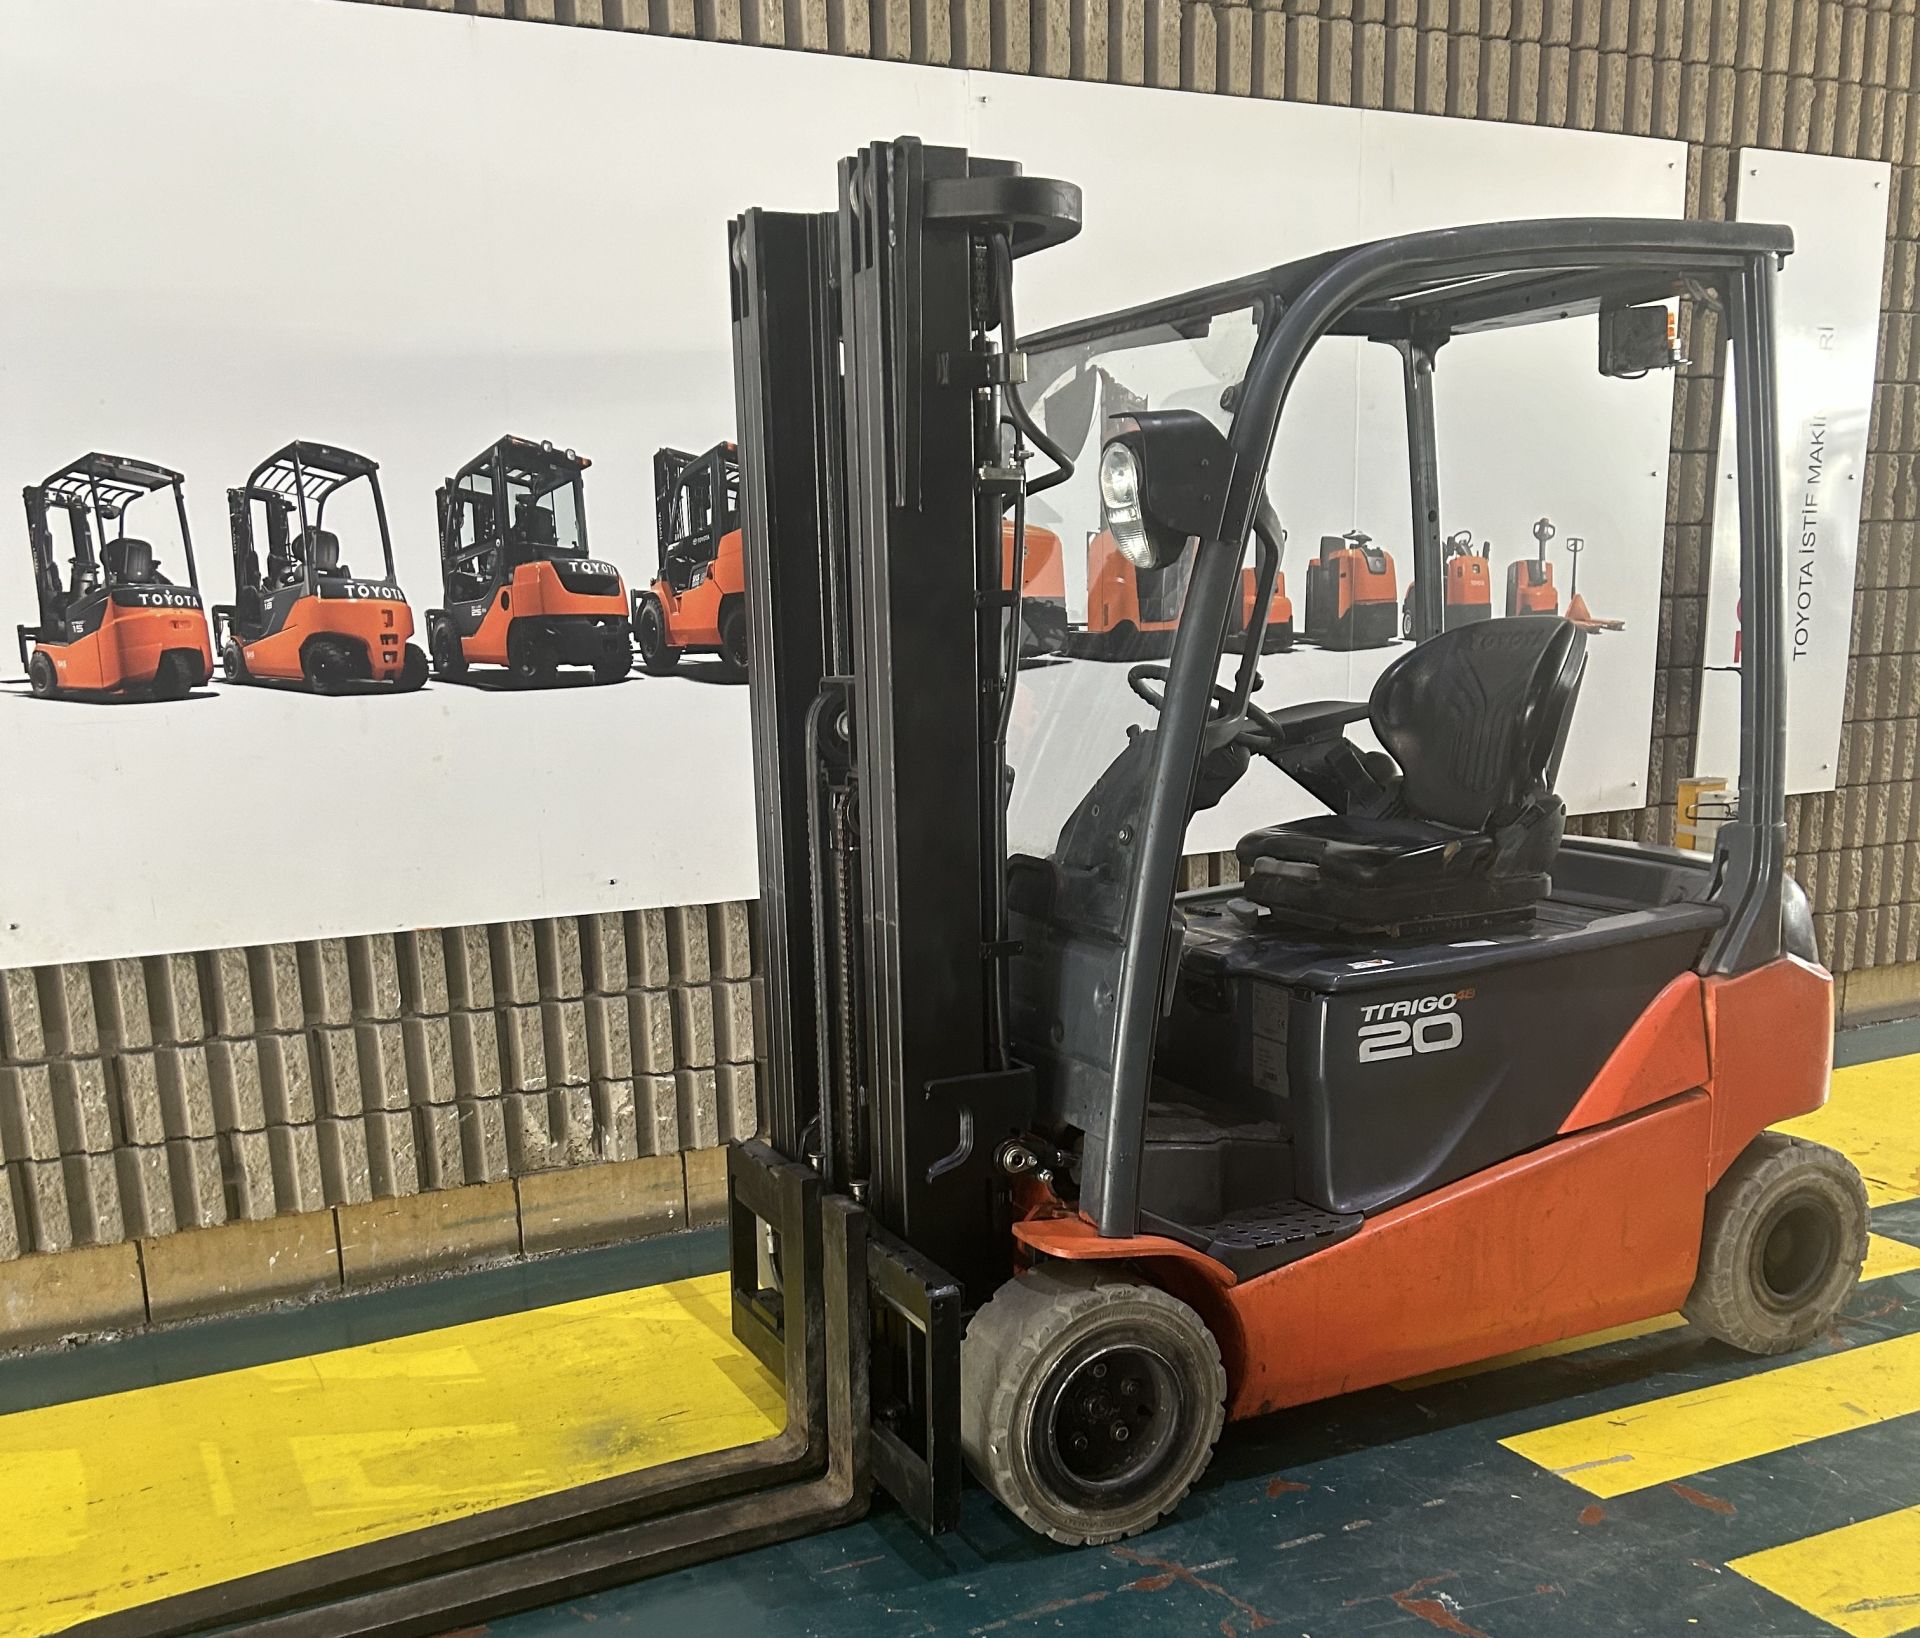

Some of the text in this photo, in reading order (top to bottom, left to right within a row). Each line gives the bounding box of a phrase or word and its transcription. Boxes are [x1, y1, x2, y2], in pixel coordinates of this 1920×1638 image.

[1799, 493, 1818, 553] İSTİF
[139, 593, 199, 607] TOYOTA
[344, 585, 405, 601] TOYOTA
[1793, 560, 1814, 662] TOYOTA
[72, 625, 84, 633] 15
[1361, 993, 1458, 1022] TRAIGO
[1358, 1012, 1463, 1063] 20
